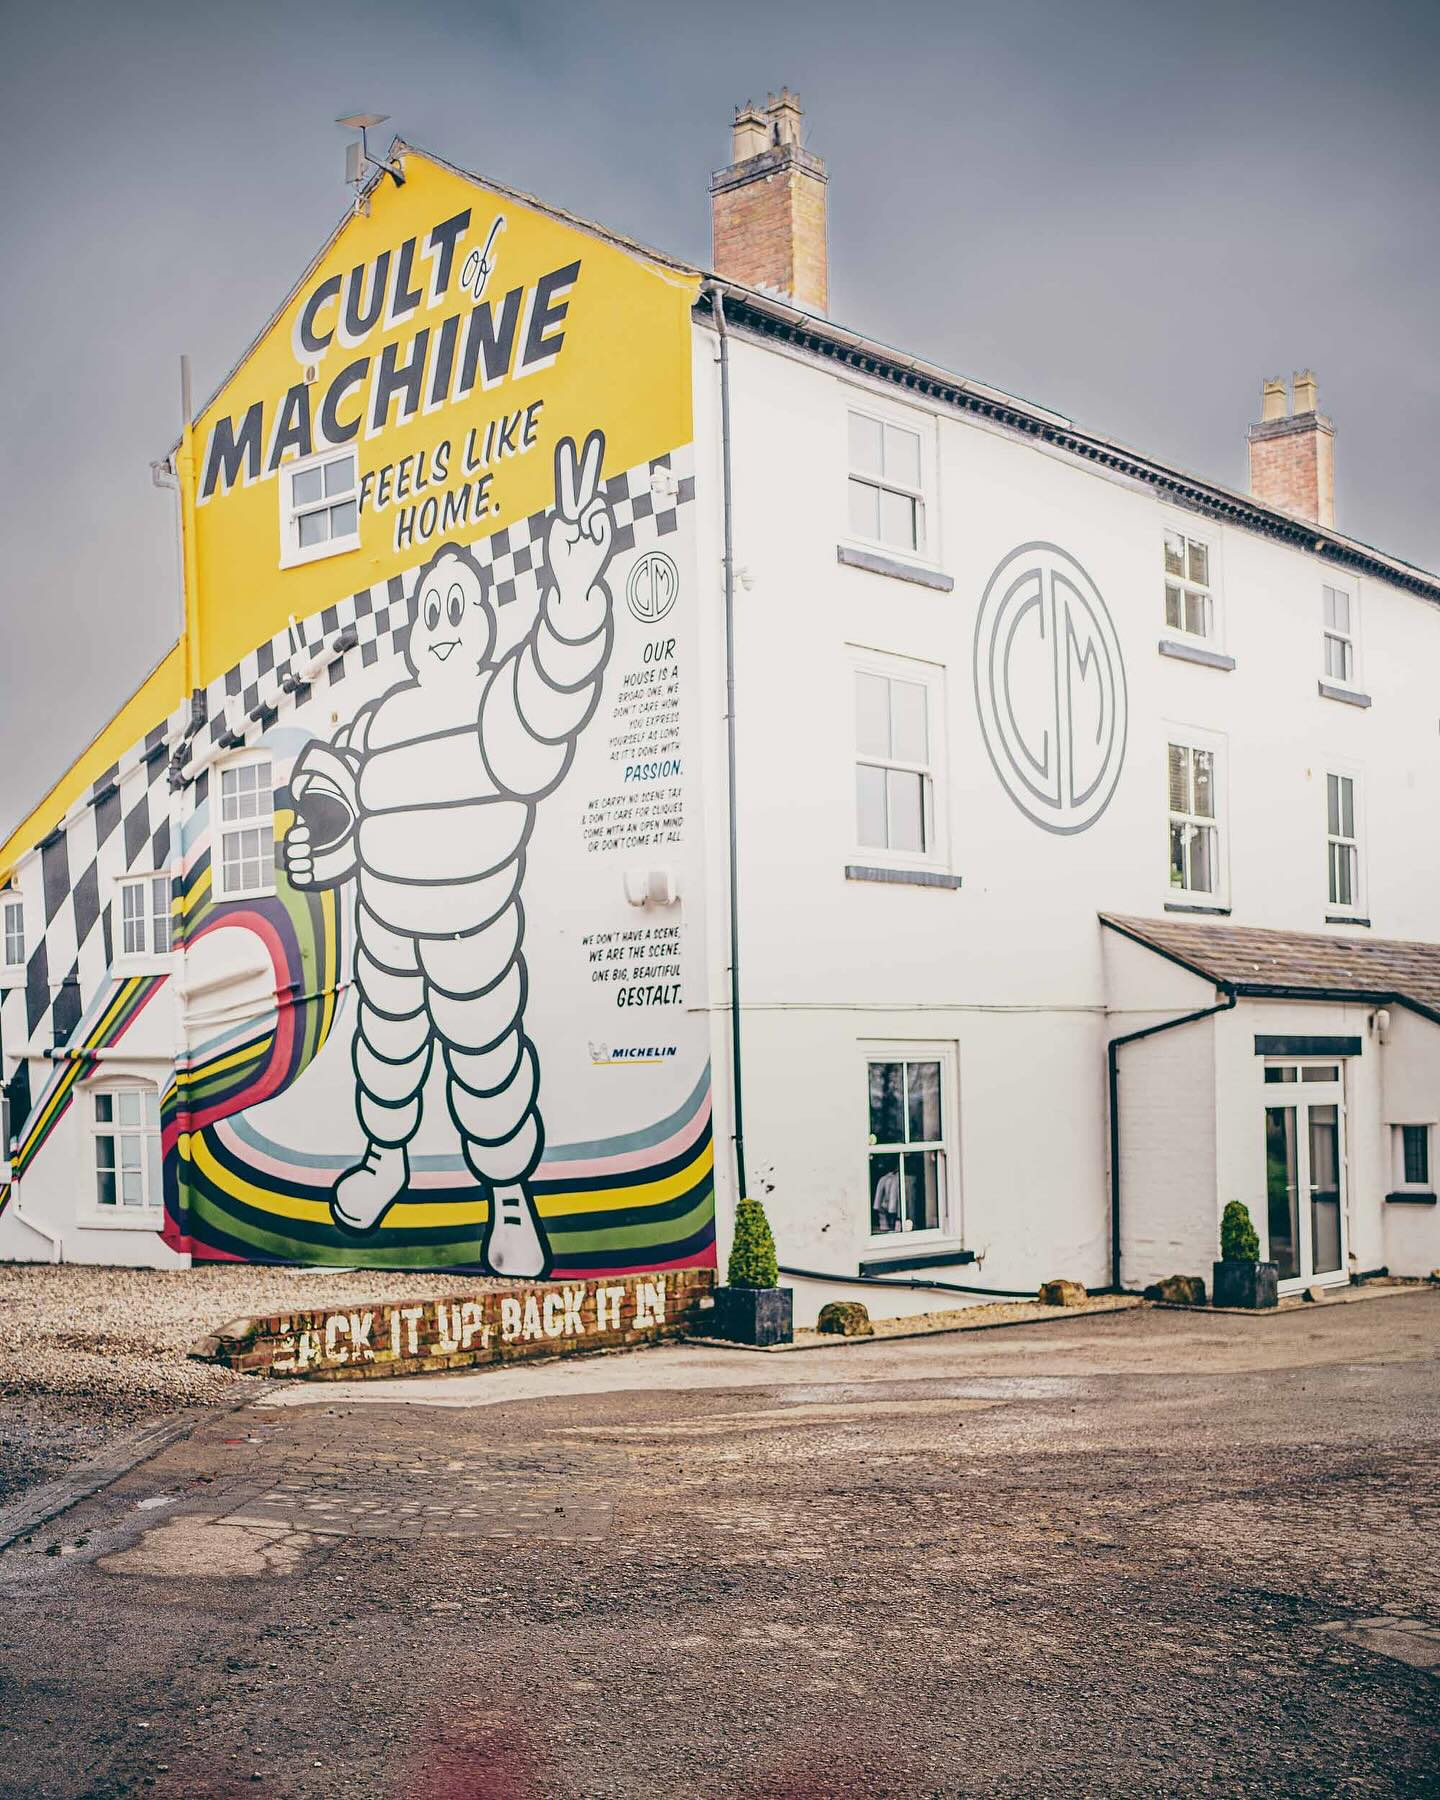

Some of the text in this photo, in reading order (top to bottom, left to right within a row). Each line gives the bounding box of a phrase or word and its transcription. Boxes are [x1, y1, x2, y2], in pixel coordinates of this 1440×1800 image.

[298, 208, 504, 355] CULT of
[201, 259, 582, 499] MACHINE
[359, 400, 545, 514] FEELS LIKE
[397, 473, 500, 550] HOME.
[643, 638, 676, 664] OUR
[624, 665, 679, 688] HOUSE IS A
[667, 682, 679, 694] WE
[639, 701, 659, 713] CARE
[645, 712, 680, 726] EXPRESS
[624, 760, 683, 783] PASSION.
[588, 798, 600, 809] WE
[601, 796, 626, 808] CARRY
[629, 793, 639, 803] NO
[641, 789, 665, 802] SCENE
[613, 808, 633, 820] CARE
[635, 806, 649, 817] FOR
[652, 802, 683, 815] CLIQUES
[584, 817, 683, 839] COME WITH AN OPEN MIND
[588, 840, 599, 852] OR
[626, 834, 651, 848] COME
[653, 832, 663, 843] AT
[583, 935, 594, 945] WE
[596, 932, 620, 944] DON'T
[622, 930, 643, 941] HAVE
[645, 929, 651, 939] A
[590, 949, 603, 962] WE
[607, 947, 624, 960] ARE
[629, 946, 645, 958] THE
[592, 969, 609, 982] ONE
[633, 964, 680, 979] BEAUTIFUL
[617, 984, 683, 1008] GESTALT.
[612, 1046, 677, 1058] MICHELIN
[391, 1307, 424, 1360] IT
[501, 1287, 586, 1342] BACK
[596, 1286, 626, 1331] IT
